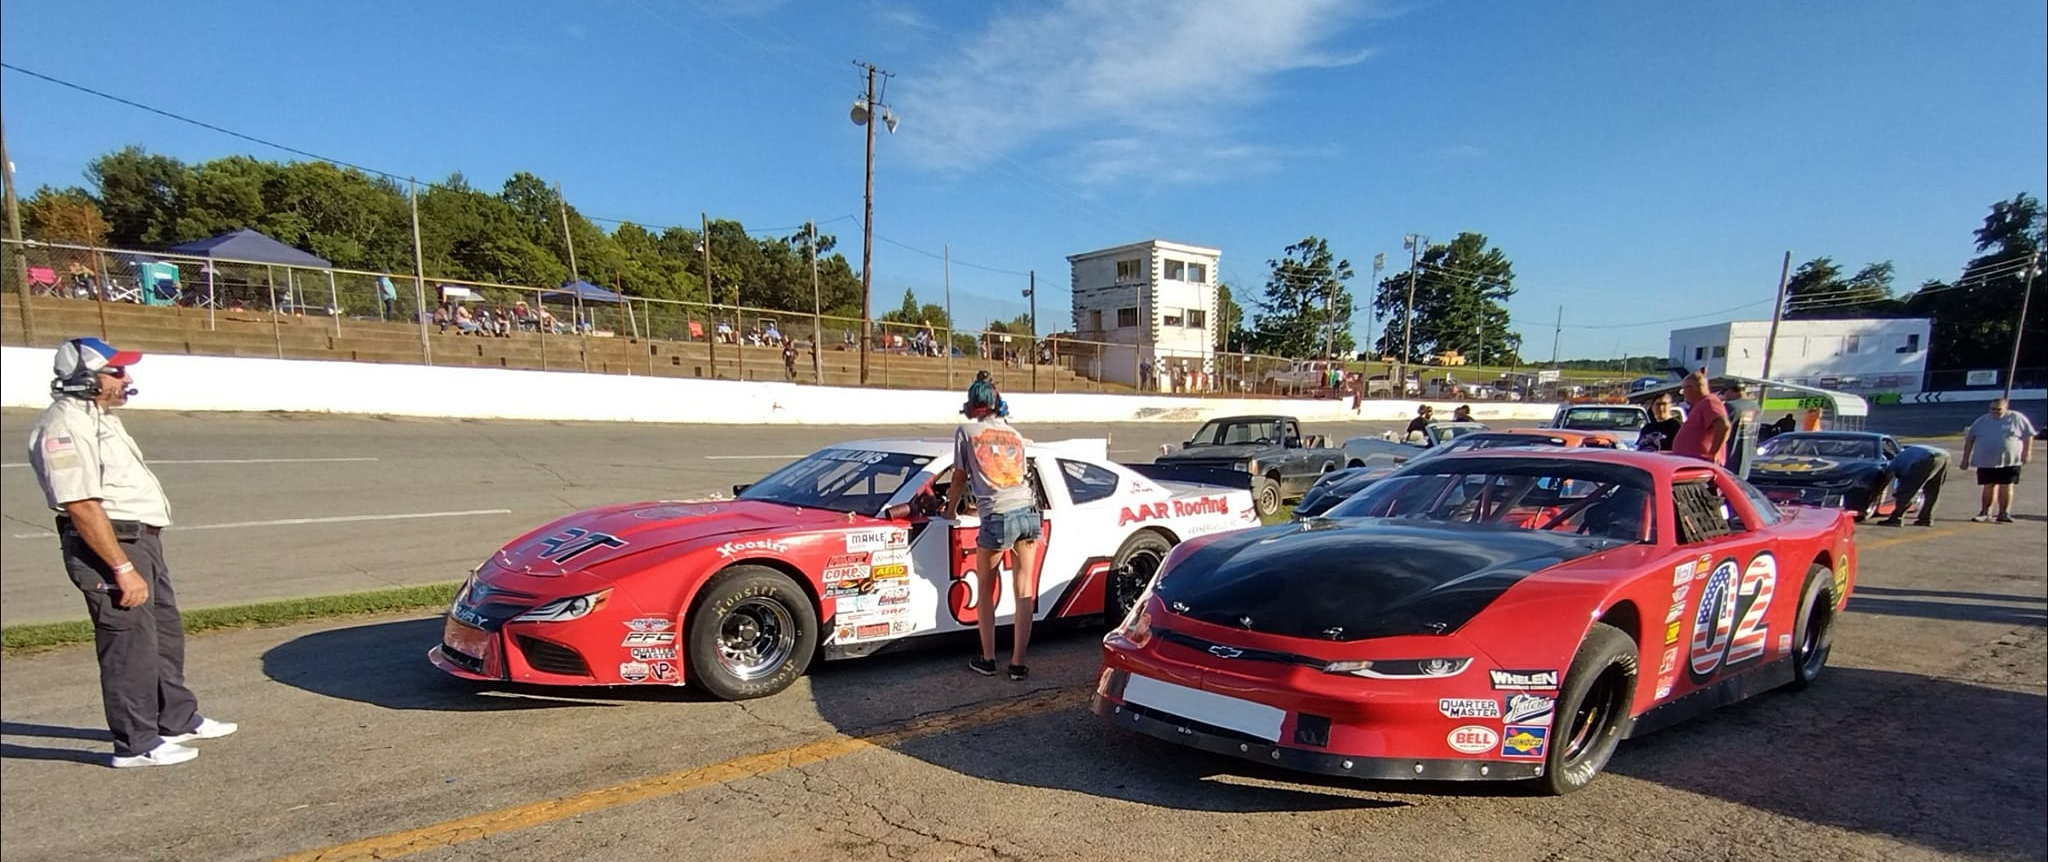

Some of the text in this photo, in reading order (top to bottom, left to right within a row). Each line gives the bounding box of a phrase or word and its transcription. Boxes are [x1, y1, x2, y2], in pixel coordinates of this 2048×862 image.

[1118, 502, 1170, 527] AAR
[1172, 495, 1229, 518] Roofing
[852, 532, 886, 544] MAHLE
[715, 537, 790, 558] Hoosier
[825, 567, 858, 580] COMP
[714, 586, 778, 618] Hoosier
[1690, 551, 1778, 682] 02
[627, 633, 675, 641] PFC
[651, 662, 670, 680] VP
[1489, 669, 1559, 685] WHELEN
[1440, 699, 1496, 712] QUARTER
[1450, 708, 1498, 718] MASTER
[1455, 732, 1491, 744] BELL
[1506, 738, 1543, 748] SUNOCO
